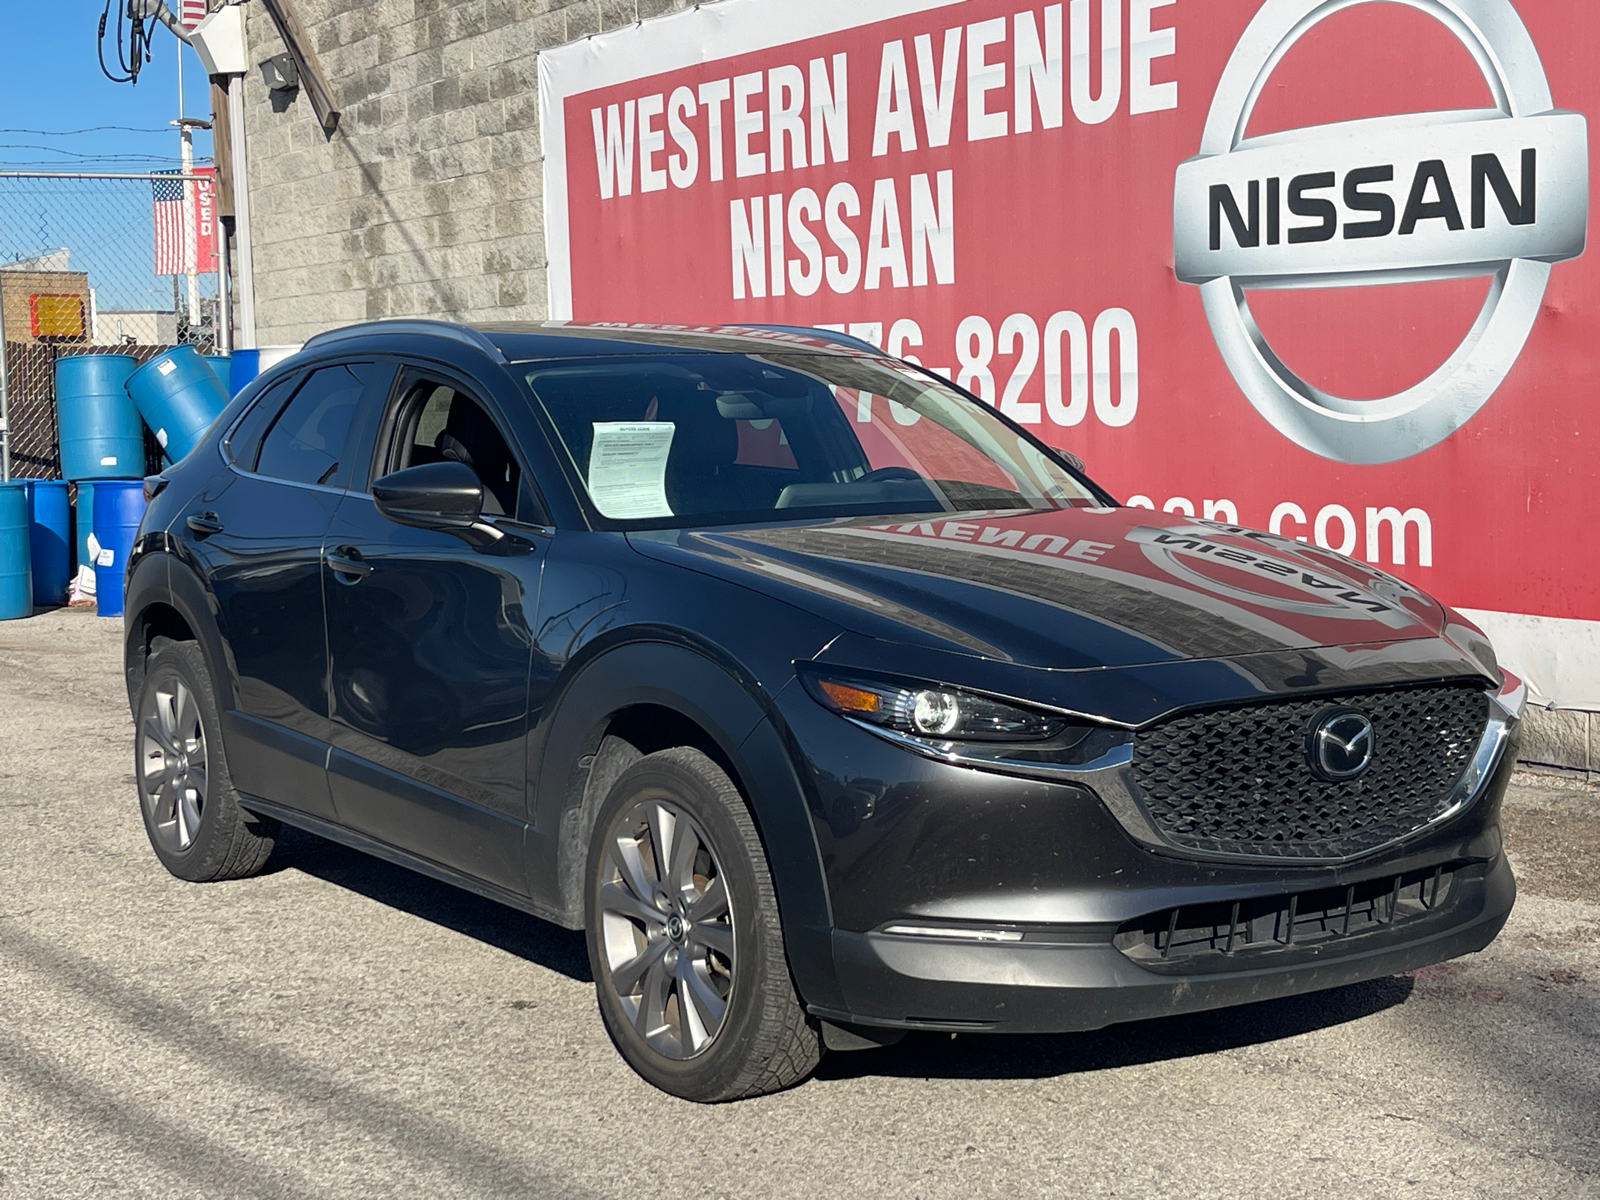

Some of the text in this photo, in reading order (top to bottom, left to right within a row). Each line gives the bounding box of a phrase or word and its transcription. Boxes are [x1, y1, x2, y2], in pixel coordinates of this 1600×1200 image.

[591, 0, 1178, 199] WESTERN AVENUE
[729, 169, 955, 299] NISSAN
[1208, 147, 1537, 251] NISSAN
